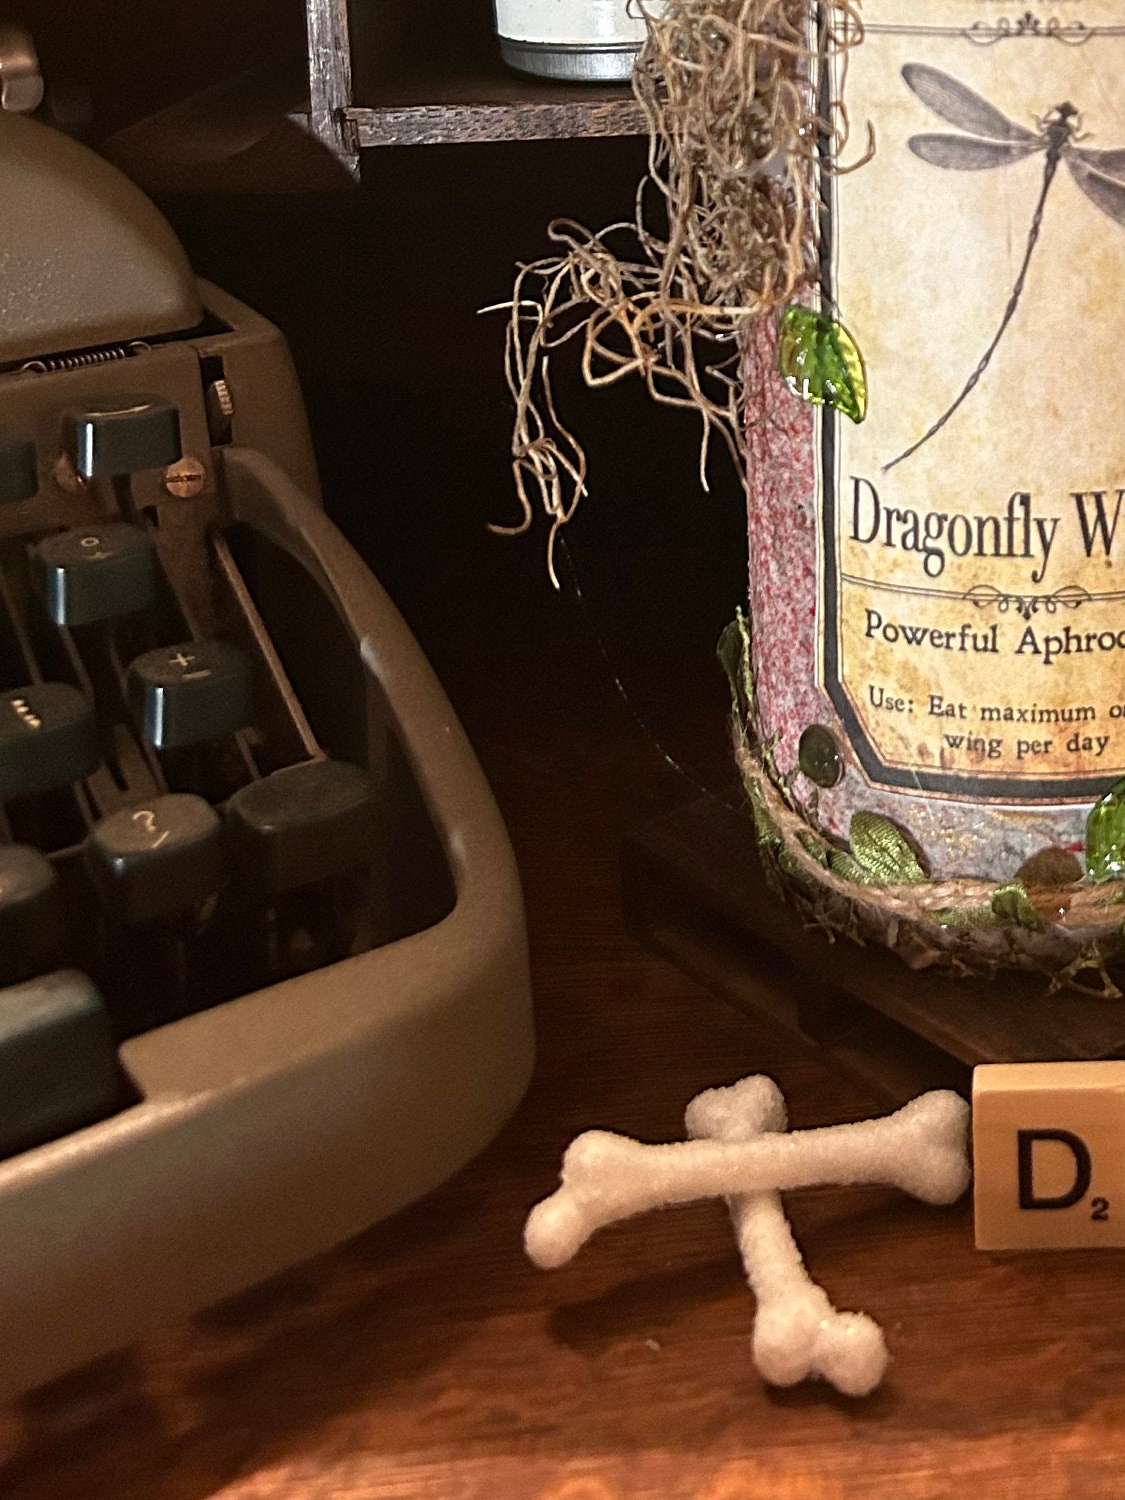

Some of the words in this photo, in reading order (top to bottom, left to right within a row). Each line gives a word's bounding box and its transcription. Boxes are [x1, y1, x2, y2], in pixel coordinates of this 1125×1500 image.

[849, 475, 1060, 583] Dragonfly
[864, 608, 999, 653] Powerful
[868, 684, 914, 713] Use:
[928, 694, 967, 719] Eat
[980, 703, 1097, 724] maximum
[944, 730, 1002, 759] wing
[1016, 739, 1053, 760] per
[1066, 732, 1111, 757] day
[1017, 1127, 1092, 1210] D
[1090, 1196, 1110, 1222] 2
